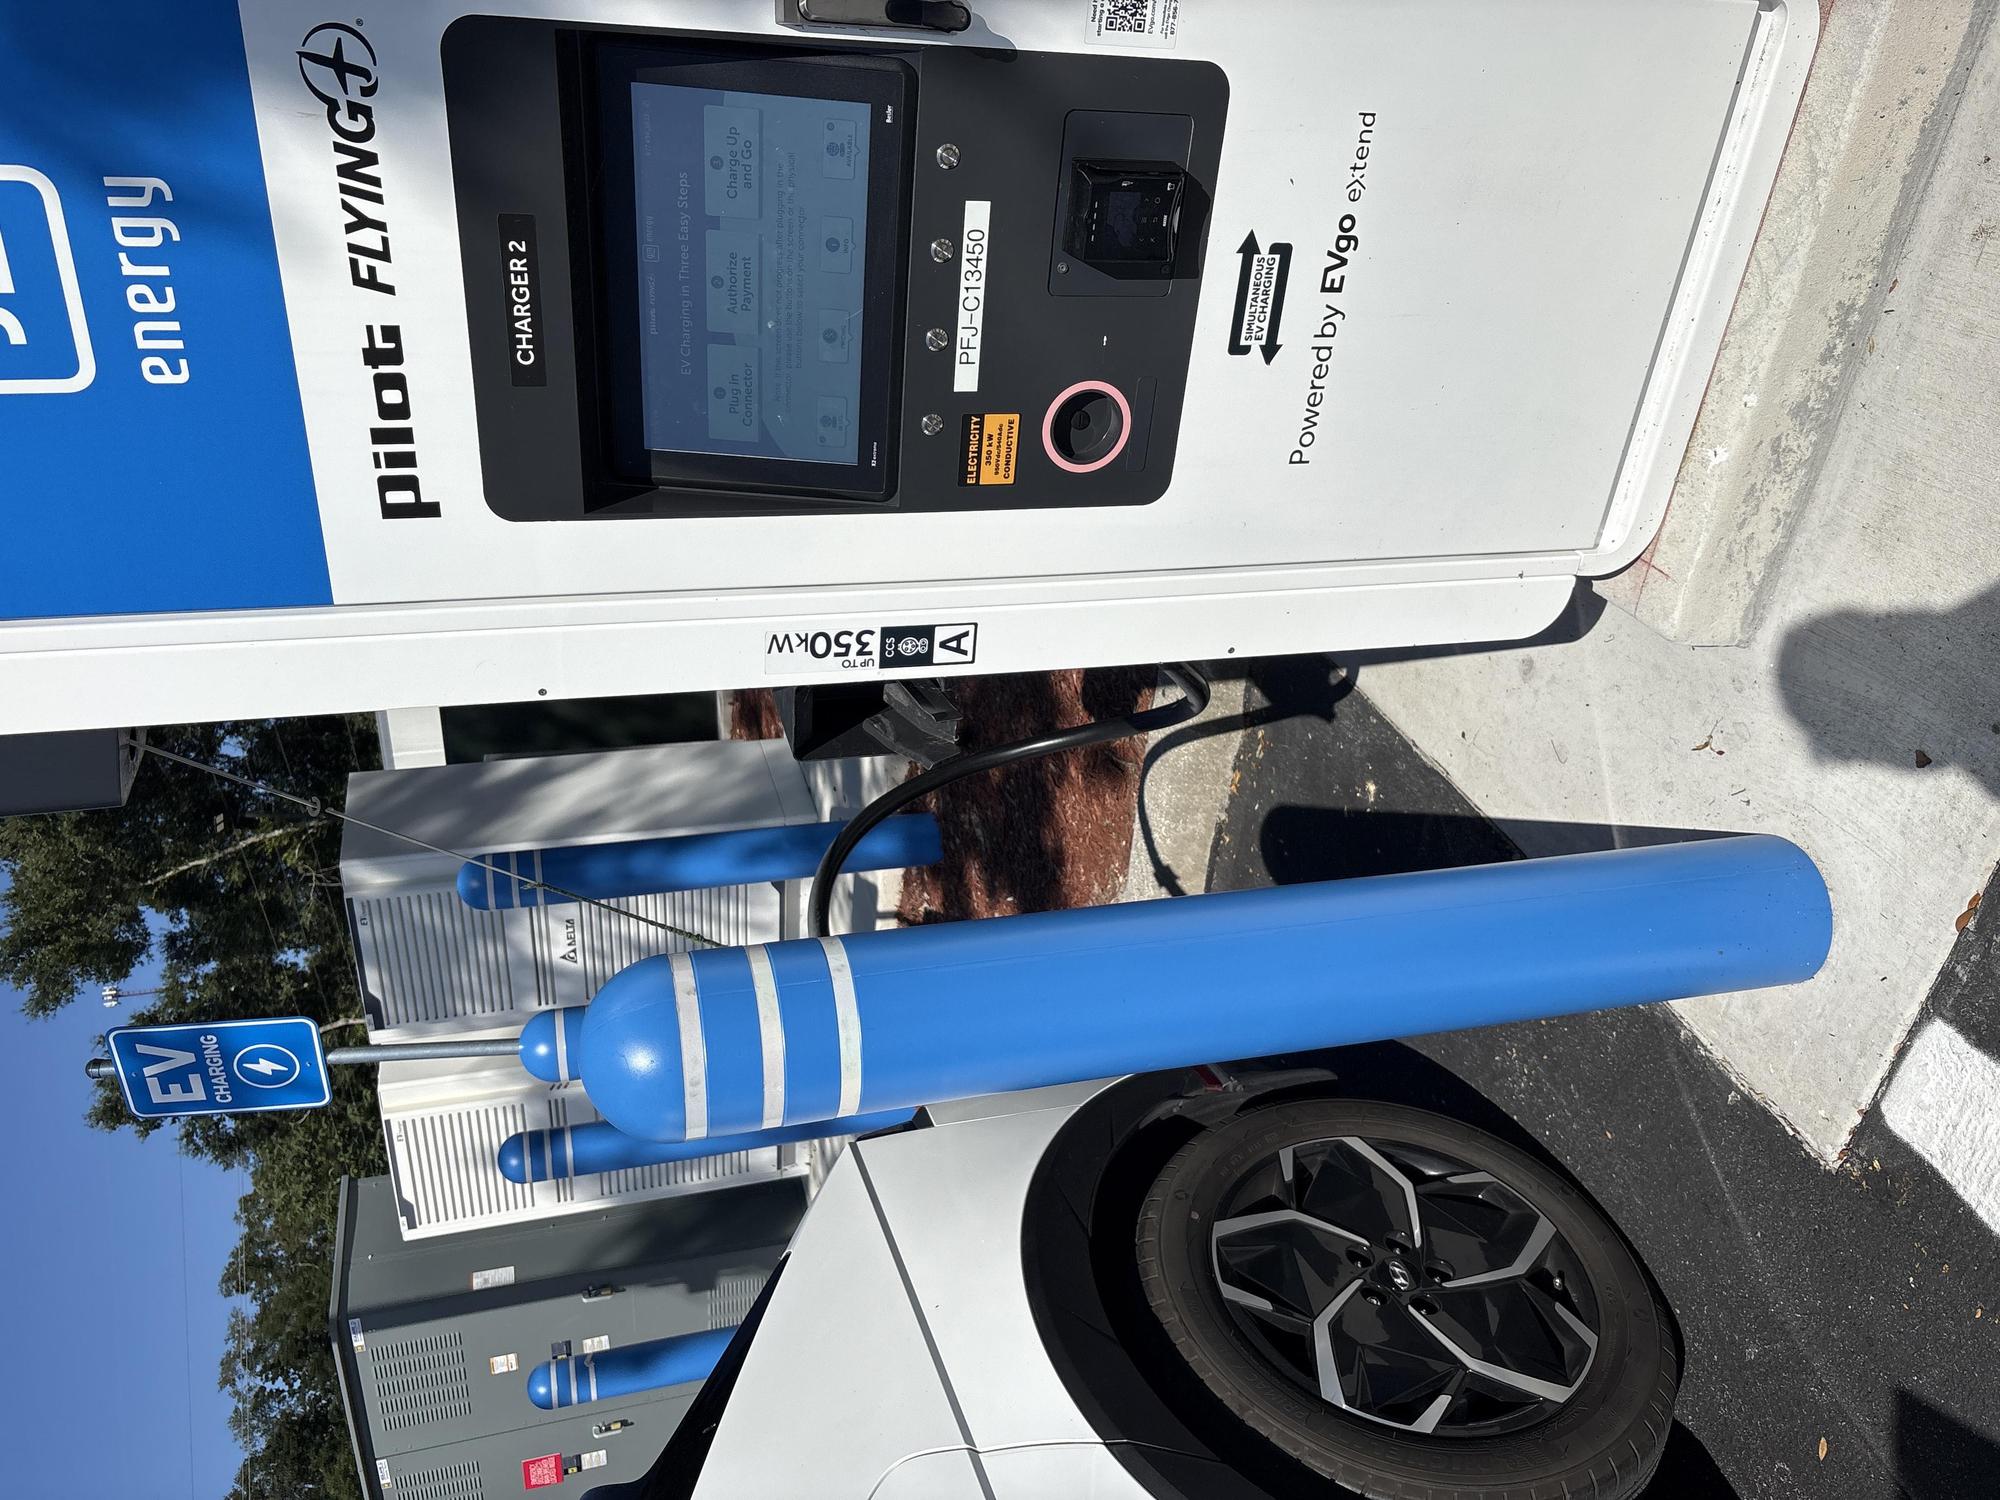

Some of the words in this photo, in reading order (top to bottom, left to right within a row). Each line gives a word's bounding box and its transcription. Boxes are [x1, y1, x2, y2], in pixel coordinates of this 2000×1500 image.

[1097, 10, 1105, 36] starting
[727, 127, 739, 145] Up
[741, 140, 752, 160] Go
[727, 150, 740, 199] Charge
[741, 164, 752, 189] and
[787, 152, 796, 188] physical
[327, 99, 396, 296] FLYING
[677, 172, 690, 208] Steps
[679, 212, 691, 240] Easy
[776, 191, 785, 228] plugging
[509, 240, 526, 252] 2
[679, 245, 689, 281] Three
[1320, 214, 1359, 293] EVgo
[103, 176, 190, 384] energy
[680, 286, 690, 296] in
[727, 251, 738, 314] Authorize
[741, 257, 754, 311] Payment
[960, 229, 985, 365] PFJ-C13450
[1258, 257, 1276, 322] CHARGING
[510, 258, 535, 365] CHARGER
[1245, 257, 1265, 341] SIMULTANEOUS
[680, 301, 692, 357] Charging
[1254, 326, 1264, 341] EV
[1314, 304, 1346, 338] by
[680, 360, 691, 375] EV
[729, 389, 741, 414] Plug
[742, 362, 753, 426] Connector
[1289, 346, 1333, 464] Powered
[362, 325, 441, 519] pilot
[986, 433, 994, 447] kW
[967, 416, 980, 483] ELECTRICITY
[1004, 419, 1014, 479] CONDUCTIVE
[767, 629, 876, 658] 350kW
[885, 637, 895, 657] CCS
[940, 630, 970, 656] A
[841, 659, 859, 668] TO
[860, 658, 875, 667] UP
[565, 919, 576, 946] DELTA
[136, 1044, 207, 1103] EV
[200, 1035, 232, 1103] CHARGING
